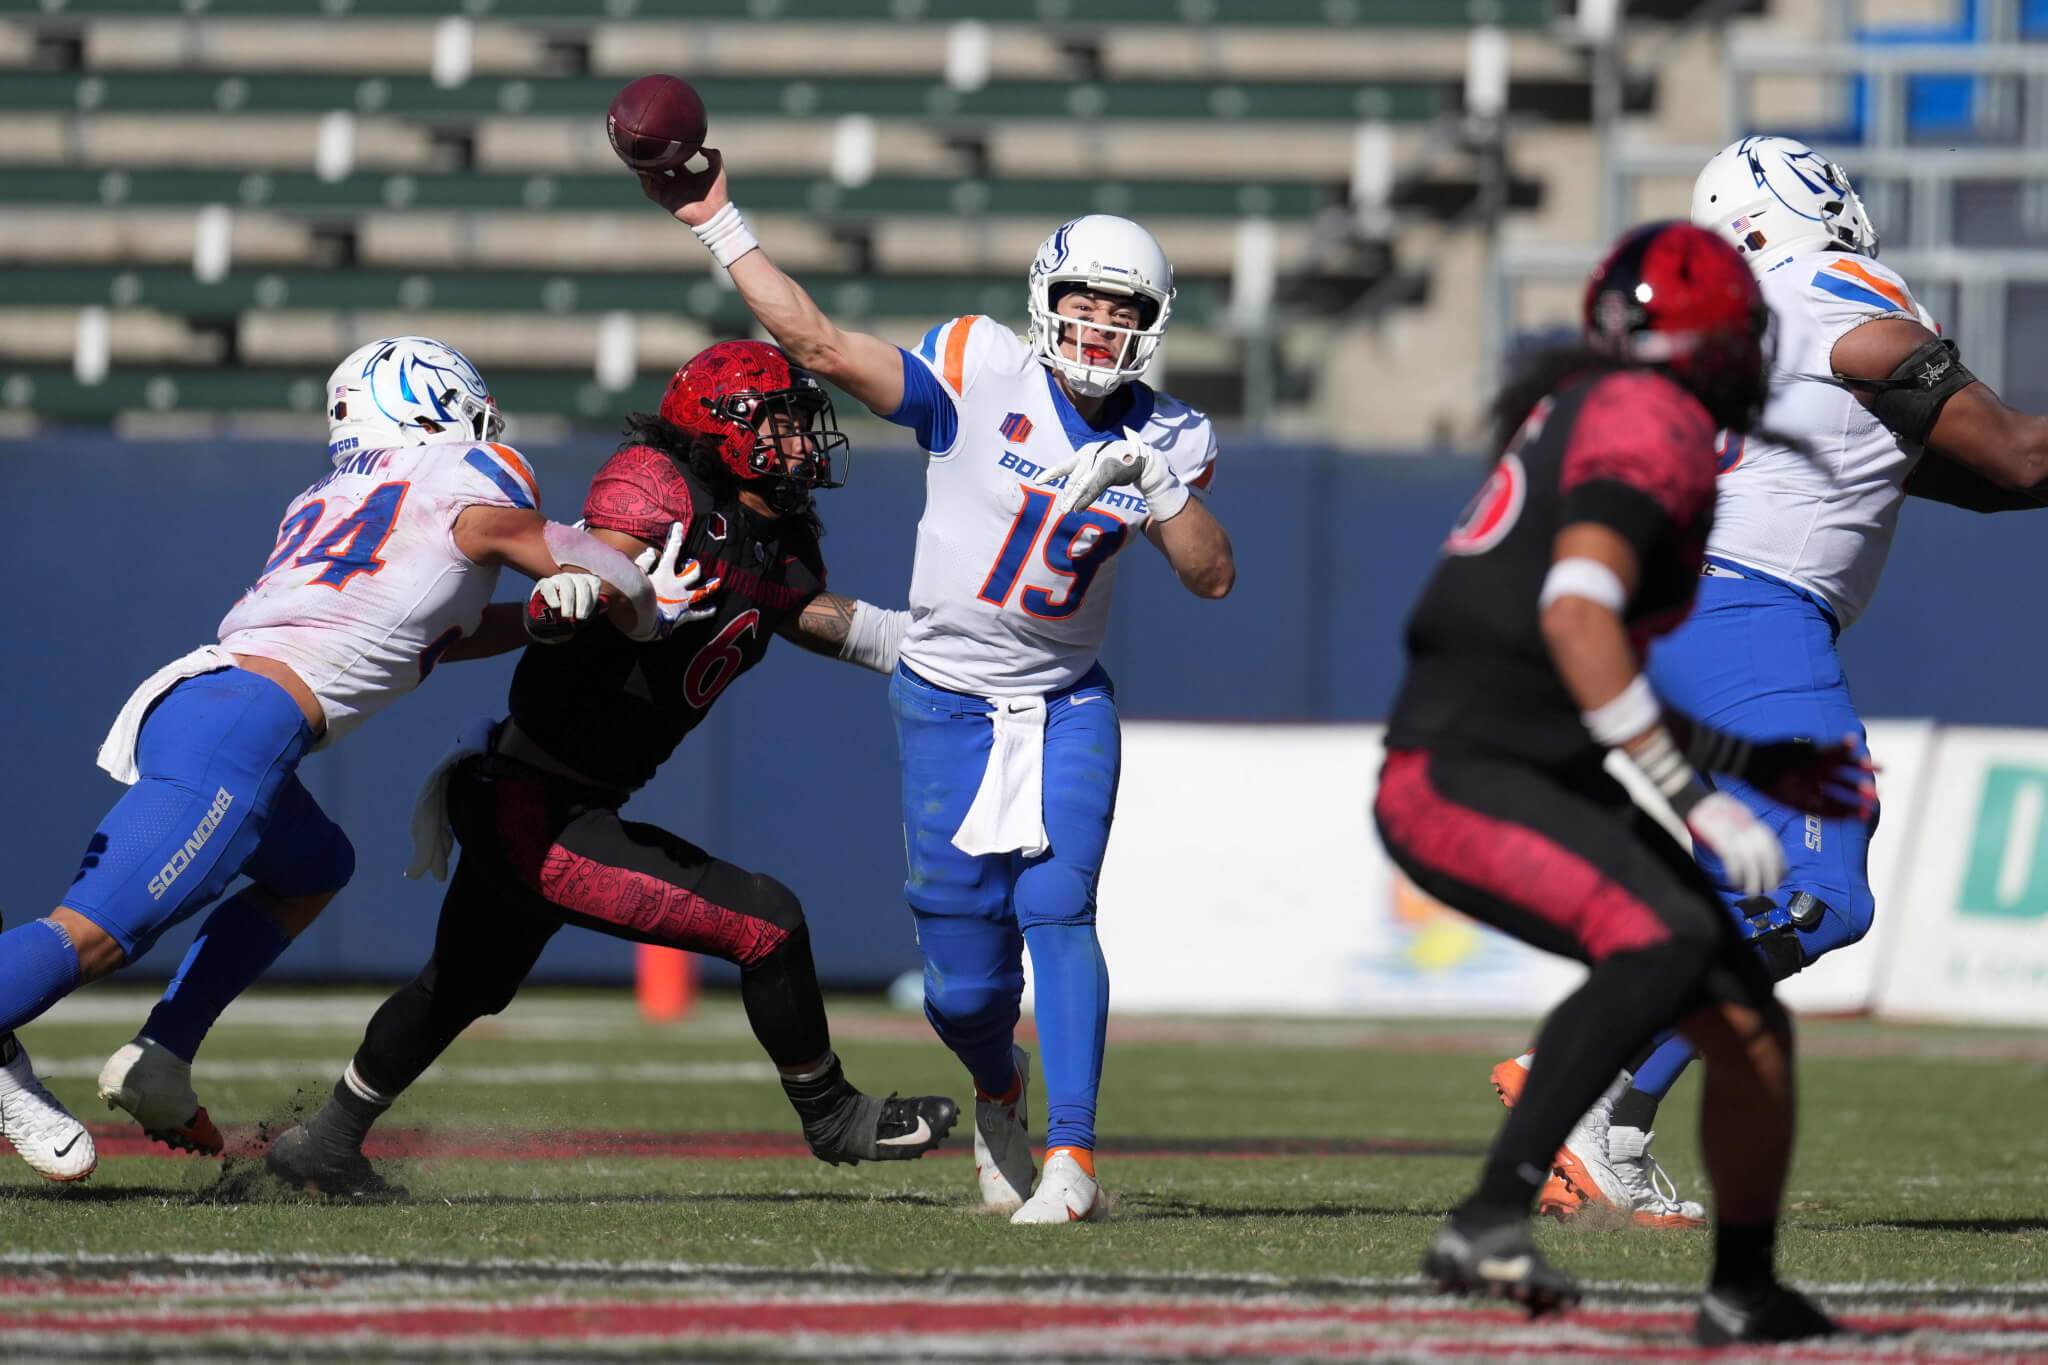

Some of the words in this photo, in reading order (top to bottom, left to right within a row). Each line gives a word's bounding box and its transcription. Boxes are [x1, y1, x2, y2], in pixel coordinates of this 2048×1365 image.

[233, 481, 411, 607] 24
[977, 483, 1128, 620] 19
[683, 607, 760, 709] 6
[147, 786, 235, 900] BRONCOS
